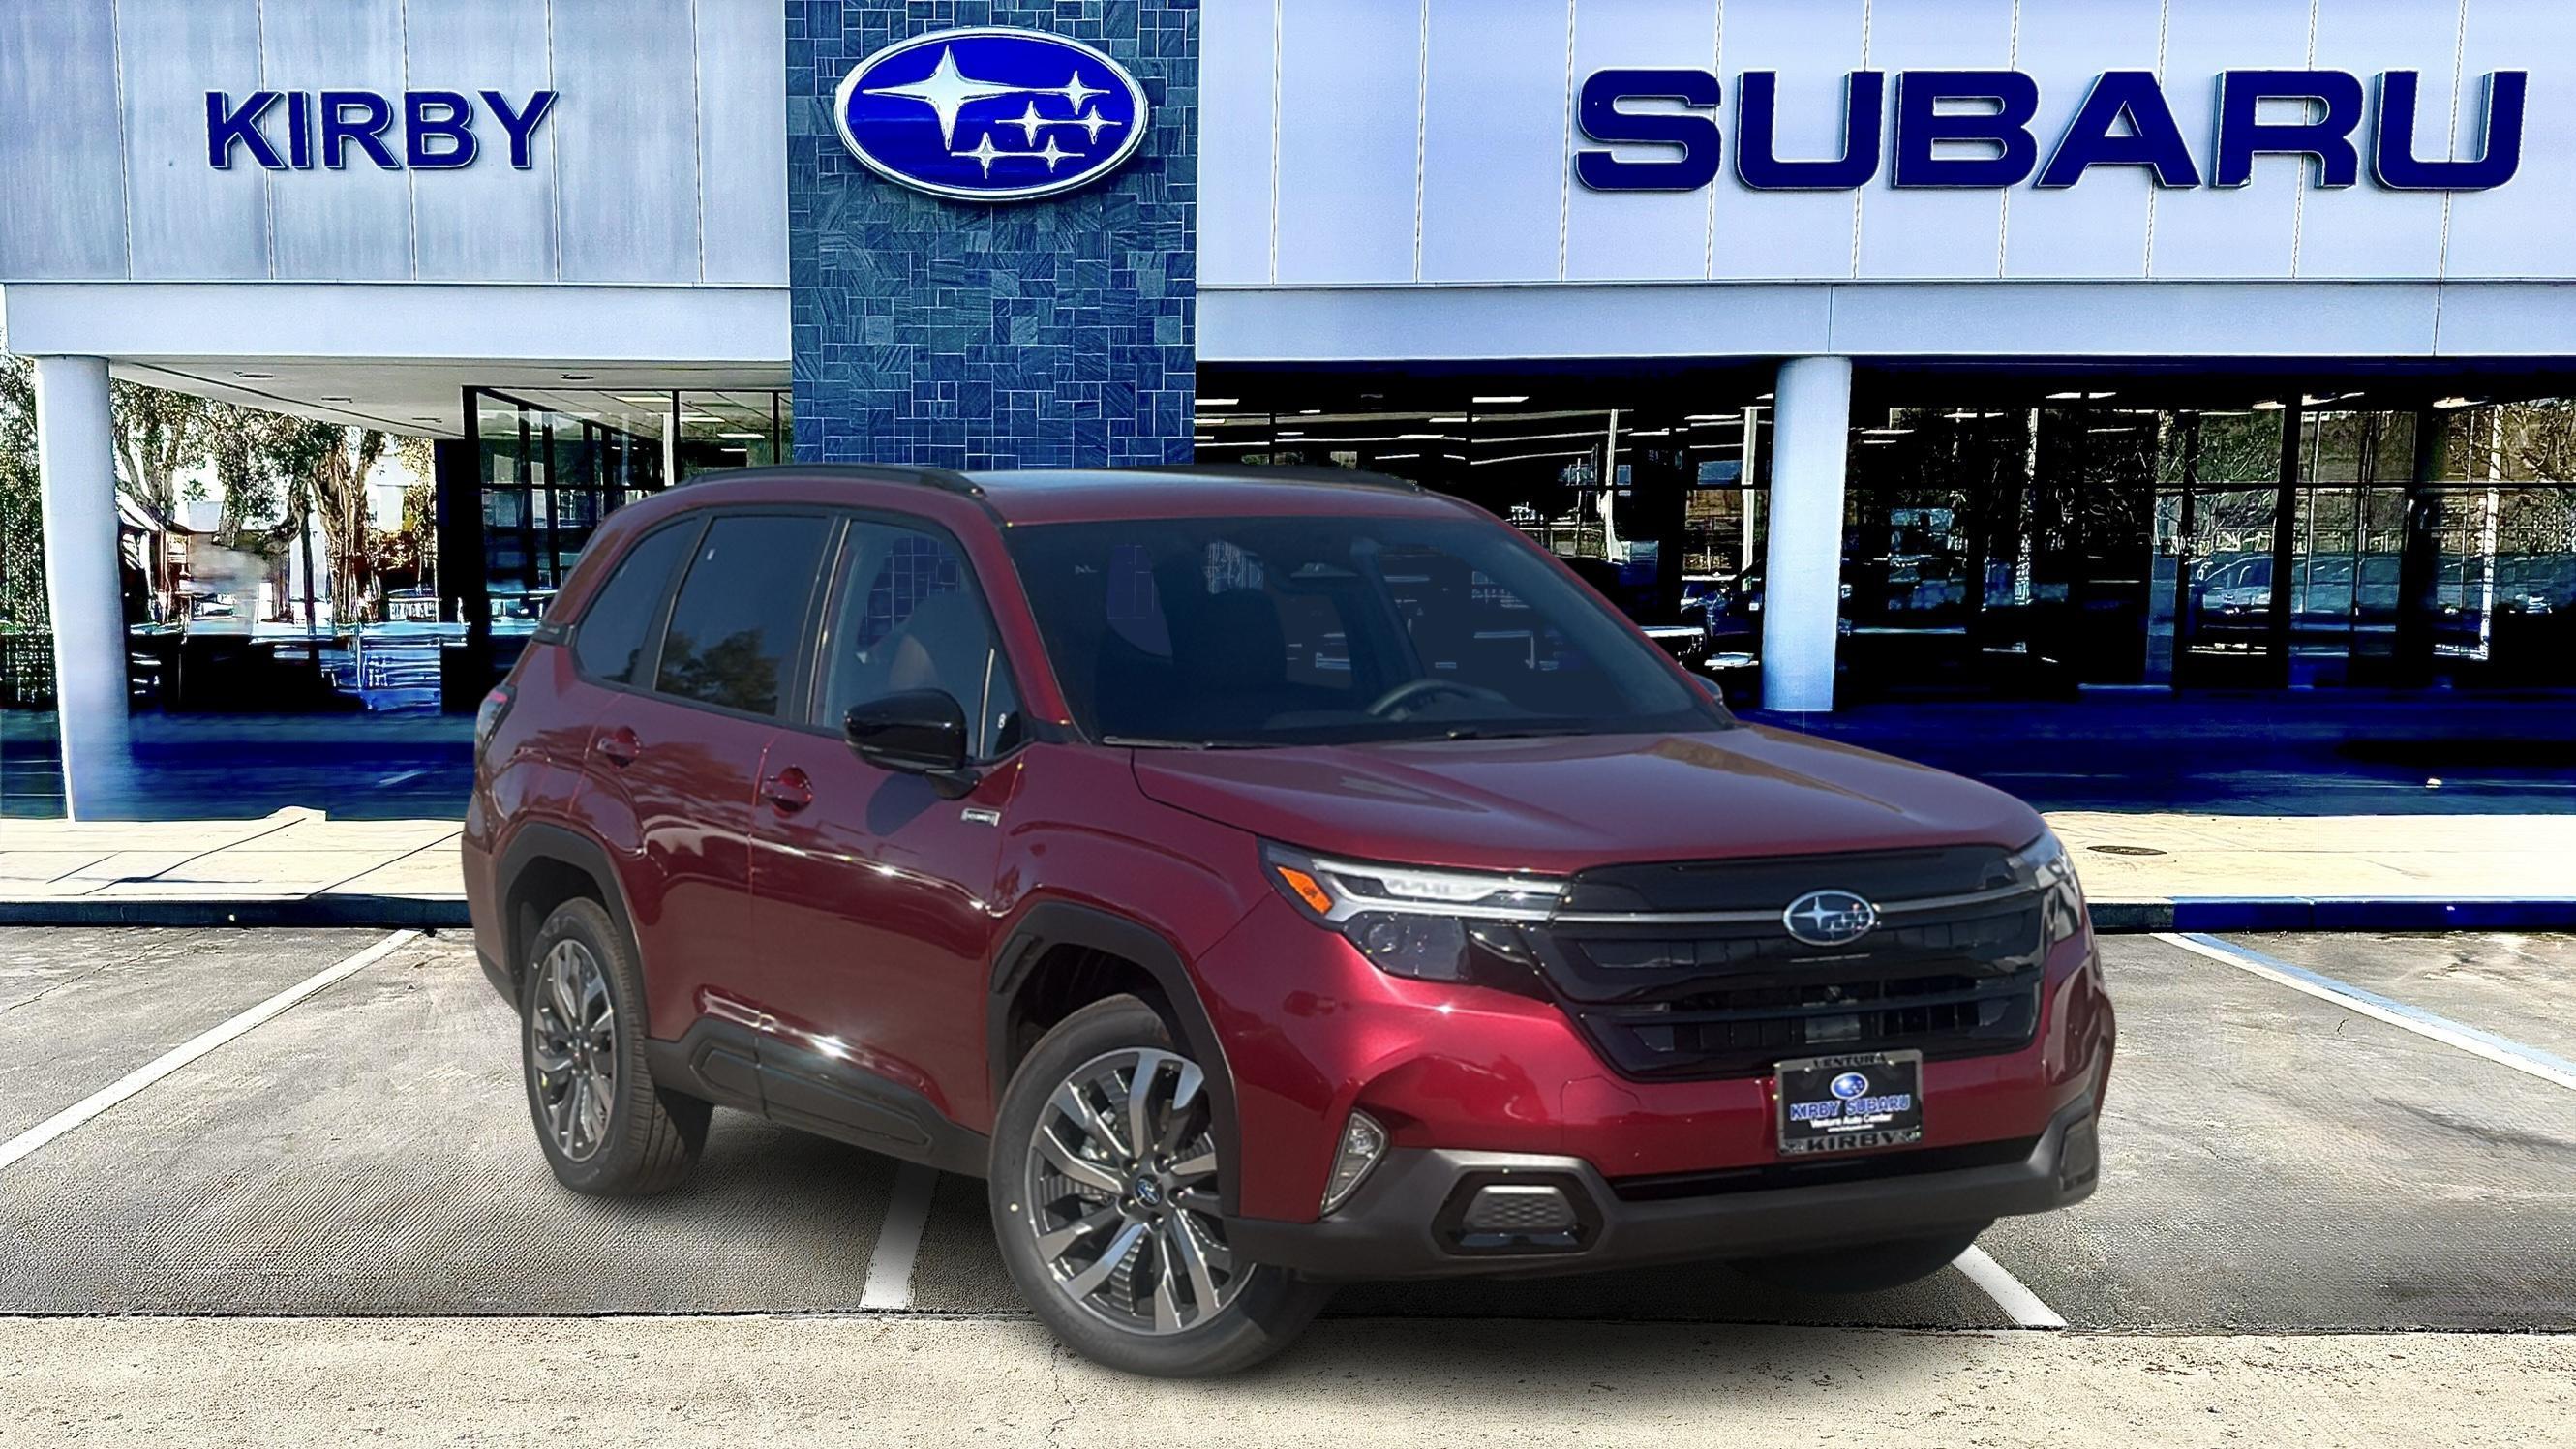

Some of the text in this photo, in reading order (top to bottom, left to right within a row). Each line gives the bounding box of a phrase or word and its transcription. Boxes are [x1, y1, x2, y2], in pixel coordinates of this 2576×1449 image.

[204, 90, 559, 170] KIRBY
[1574, 68, 2528, 191] SUBARU
[1813, 1053, 1886, 1068] VENTURA
[1790, 1095, 1910, 1120] KIRBY SUBARU
[1807, 1132, 1897, 1151] KIRBY
